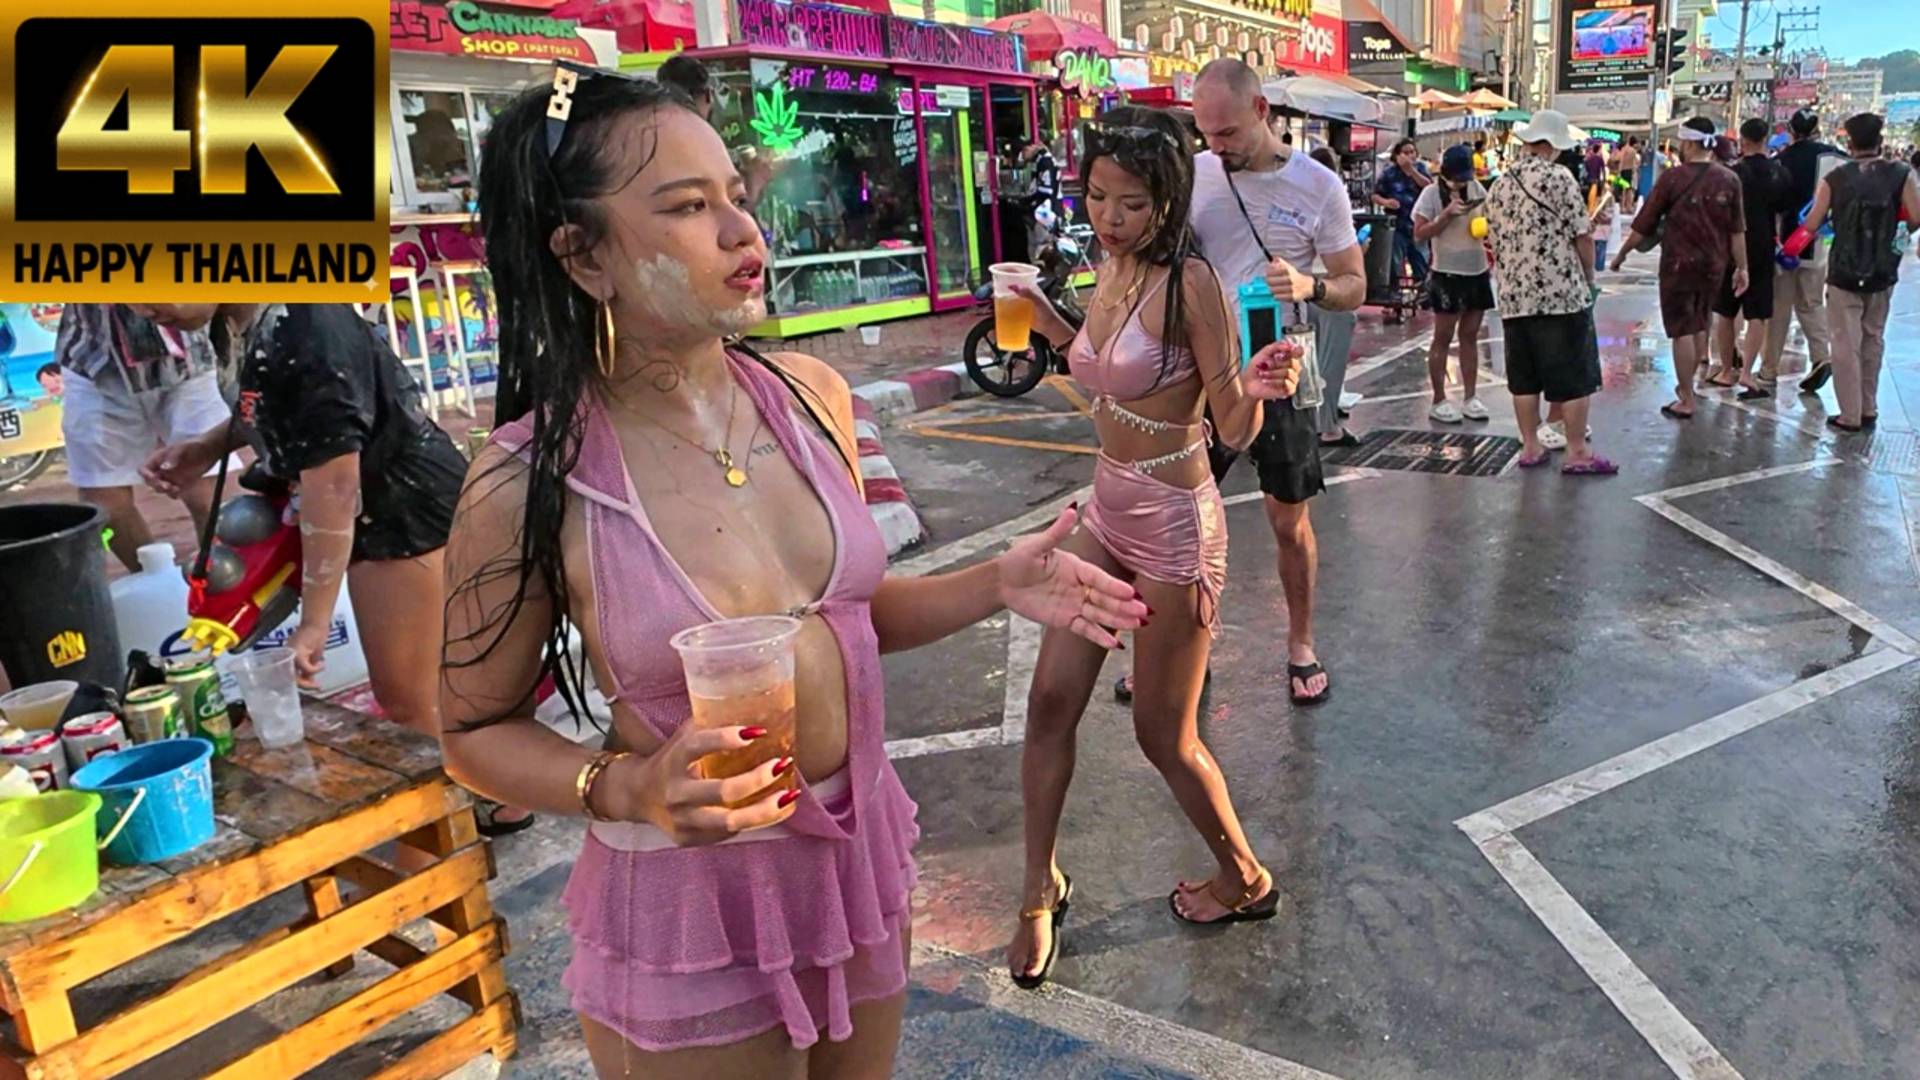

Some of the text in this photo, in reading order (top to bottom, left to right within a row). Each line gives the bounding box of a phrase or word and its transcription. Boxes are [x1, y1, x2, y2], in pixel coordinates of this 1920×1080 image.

[793, 4, 883, 58] PREMIUM
[460, 37, 519, 54] SHOP
[1363, 36, 1392, 52] Tops
